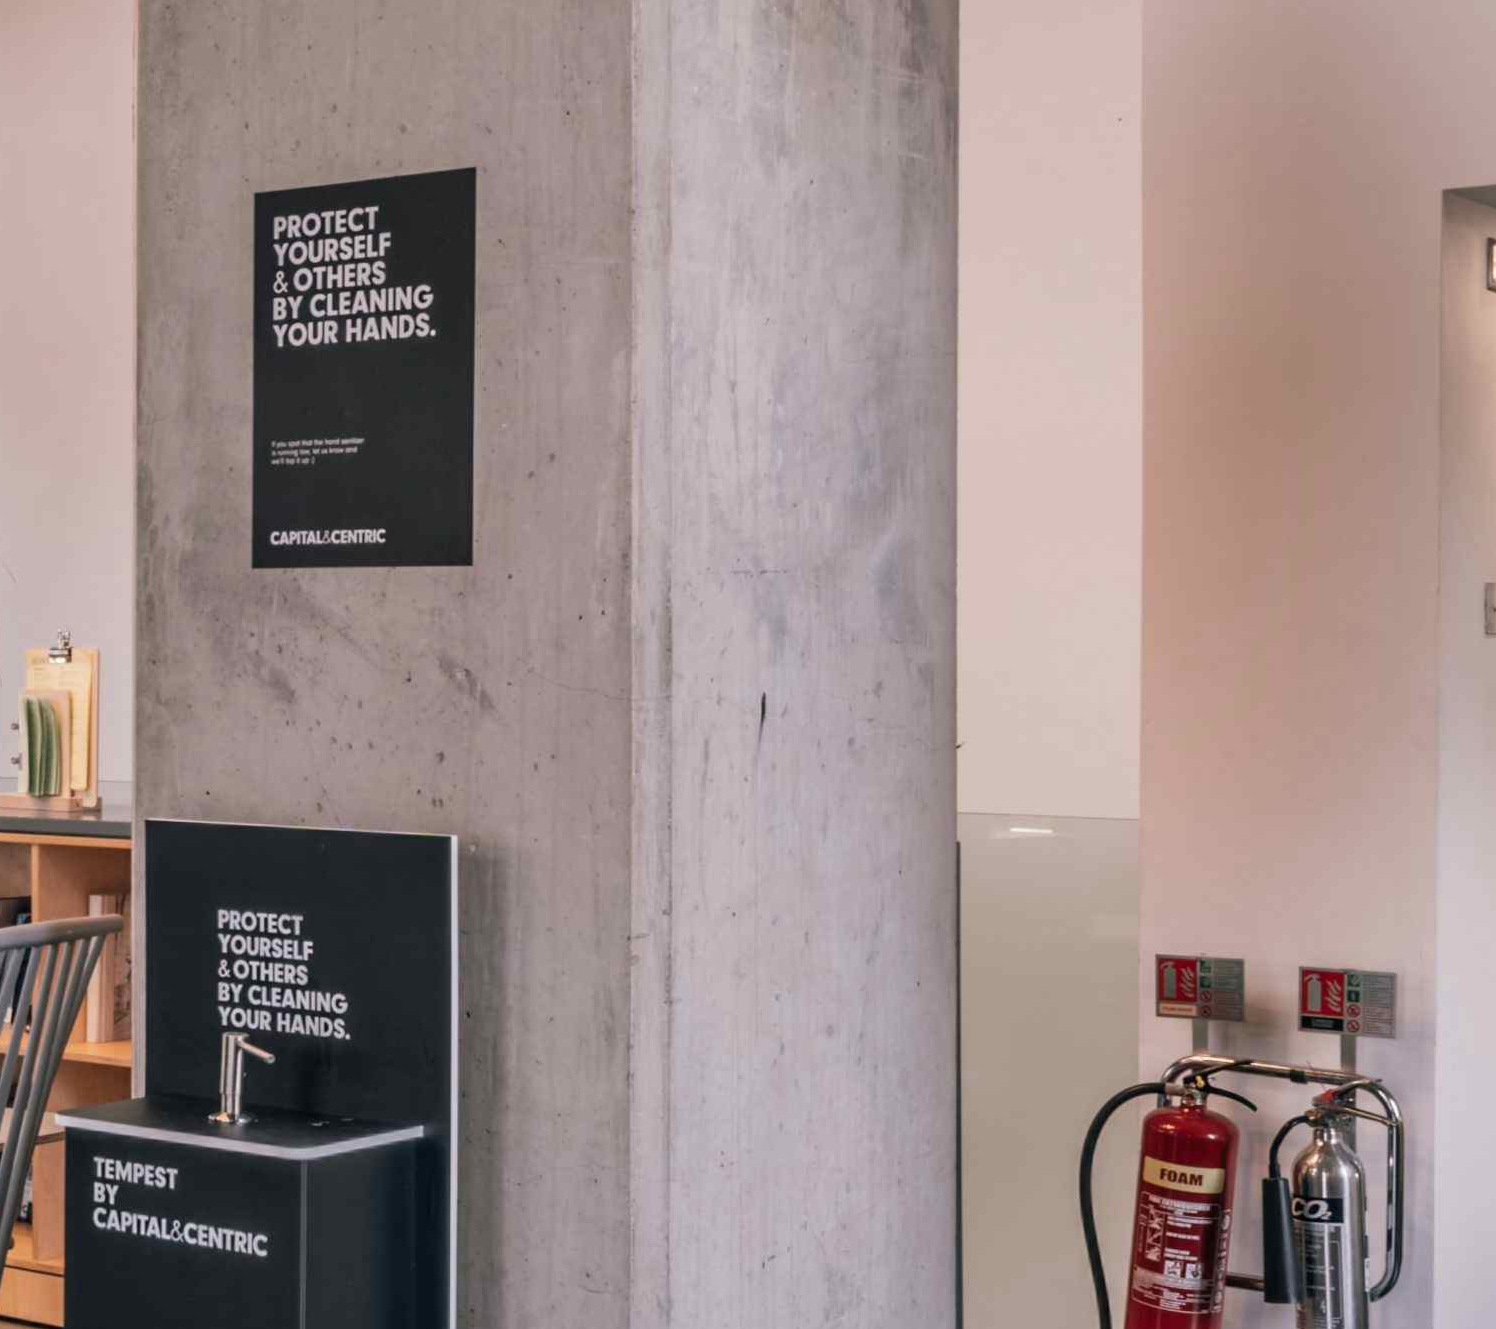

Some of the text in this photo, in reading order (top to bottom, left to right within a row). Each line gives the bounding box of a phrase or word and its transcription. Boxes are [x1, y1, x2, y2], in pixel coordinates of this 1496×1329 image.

[272, 206, 380, 240] PROTECT
[272, 232, 392, 266] YOURSELF
[273, 261, 387, 294] & OTHERS
[273, 285, 434, 321] BY CLEANING
[272, 312, 436, 348] YOUR HANDS.
[270, 528, 386, 546] CAPITAL&CENTRIC
[217, 909, 304, 936] PROTECT
[217, 933, 314, 961] YOURSELF
[217, 959, 309, 986] & OTHERS
[217, 982, 349, 1015] BY CLEANING
[217, 1006, 351, 1041] YOUR HANDS.
[93, 1156, 179, 1190] TEMPEST
[1159, 1168, 1204, 1187] FOAM
[93, 1182, 120, 1206] BY
[93, 1207, 269, 1258] CAPITAL&CENTRIC
